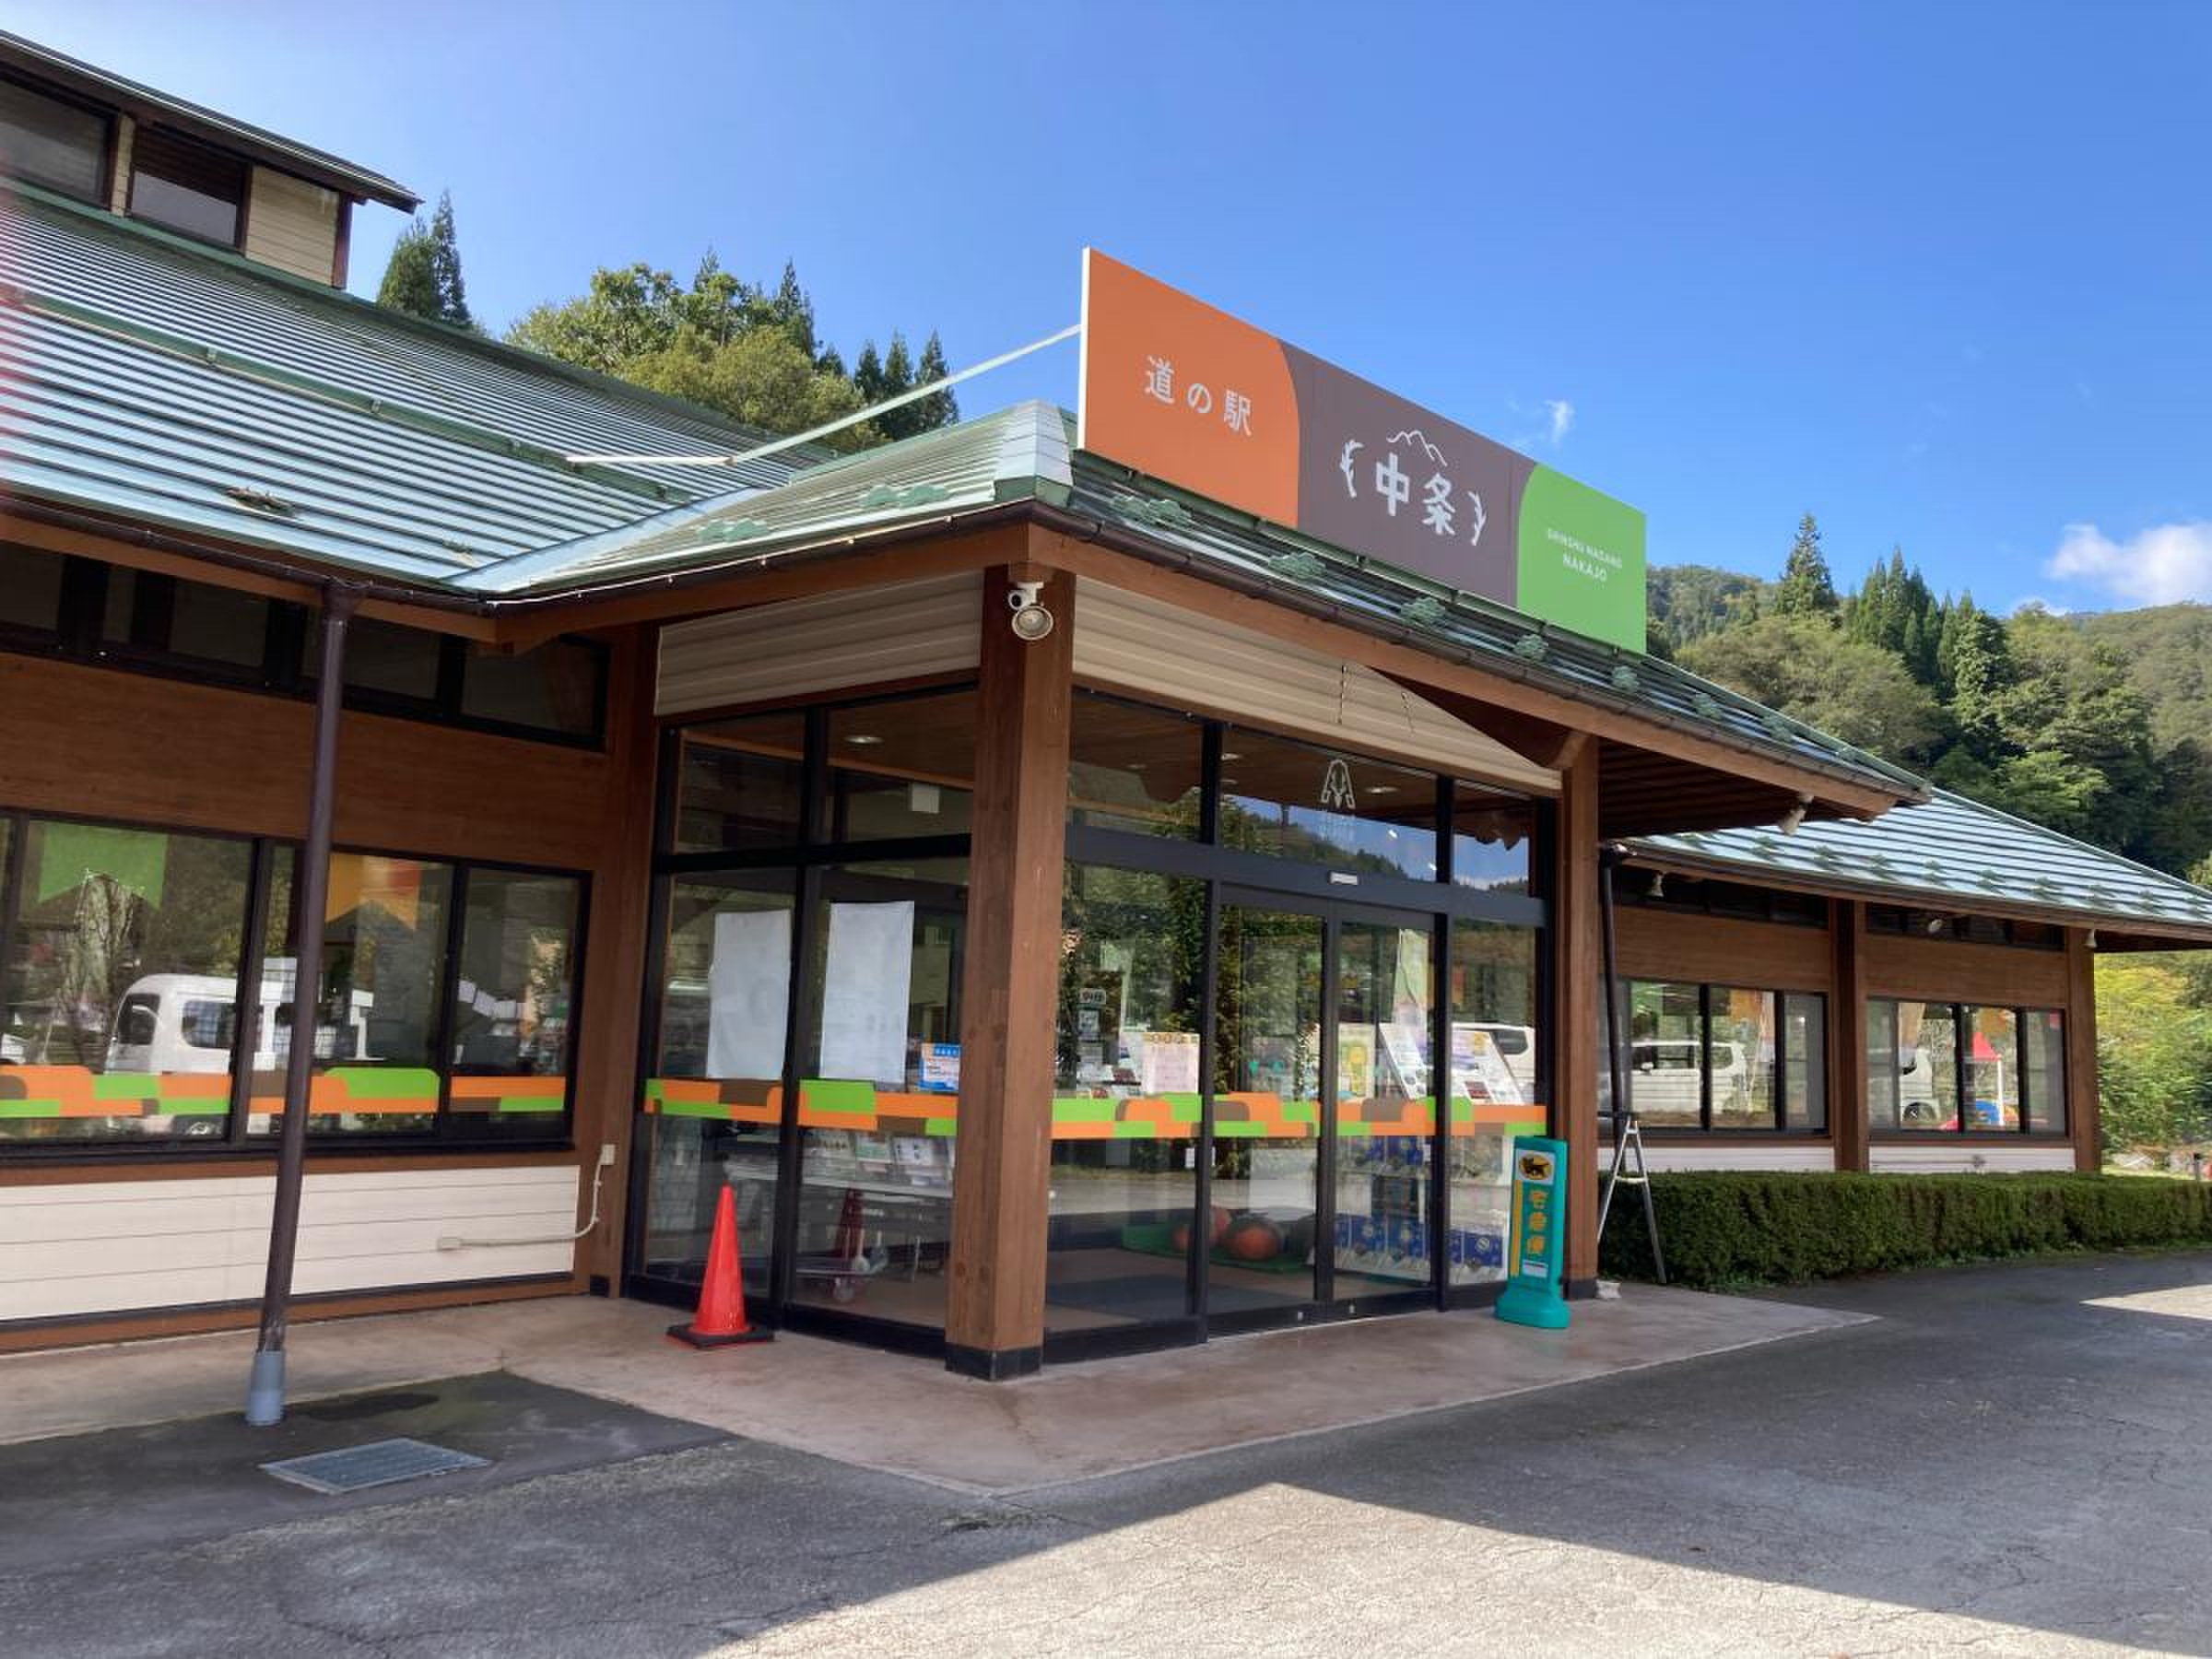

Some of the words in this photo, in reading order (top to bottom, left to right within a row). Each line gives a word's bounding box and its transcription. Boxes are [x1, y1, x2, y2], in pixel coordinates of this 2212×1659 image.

[1144, 355, 1253, 437] 道の駅
[1376, 452, 1456, 535] 中条
[1563, 553, 1607, 582] NAKAJO
